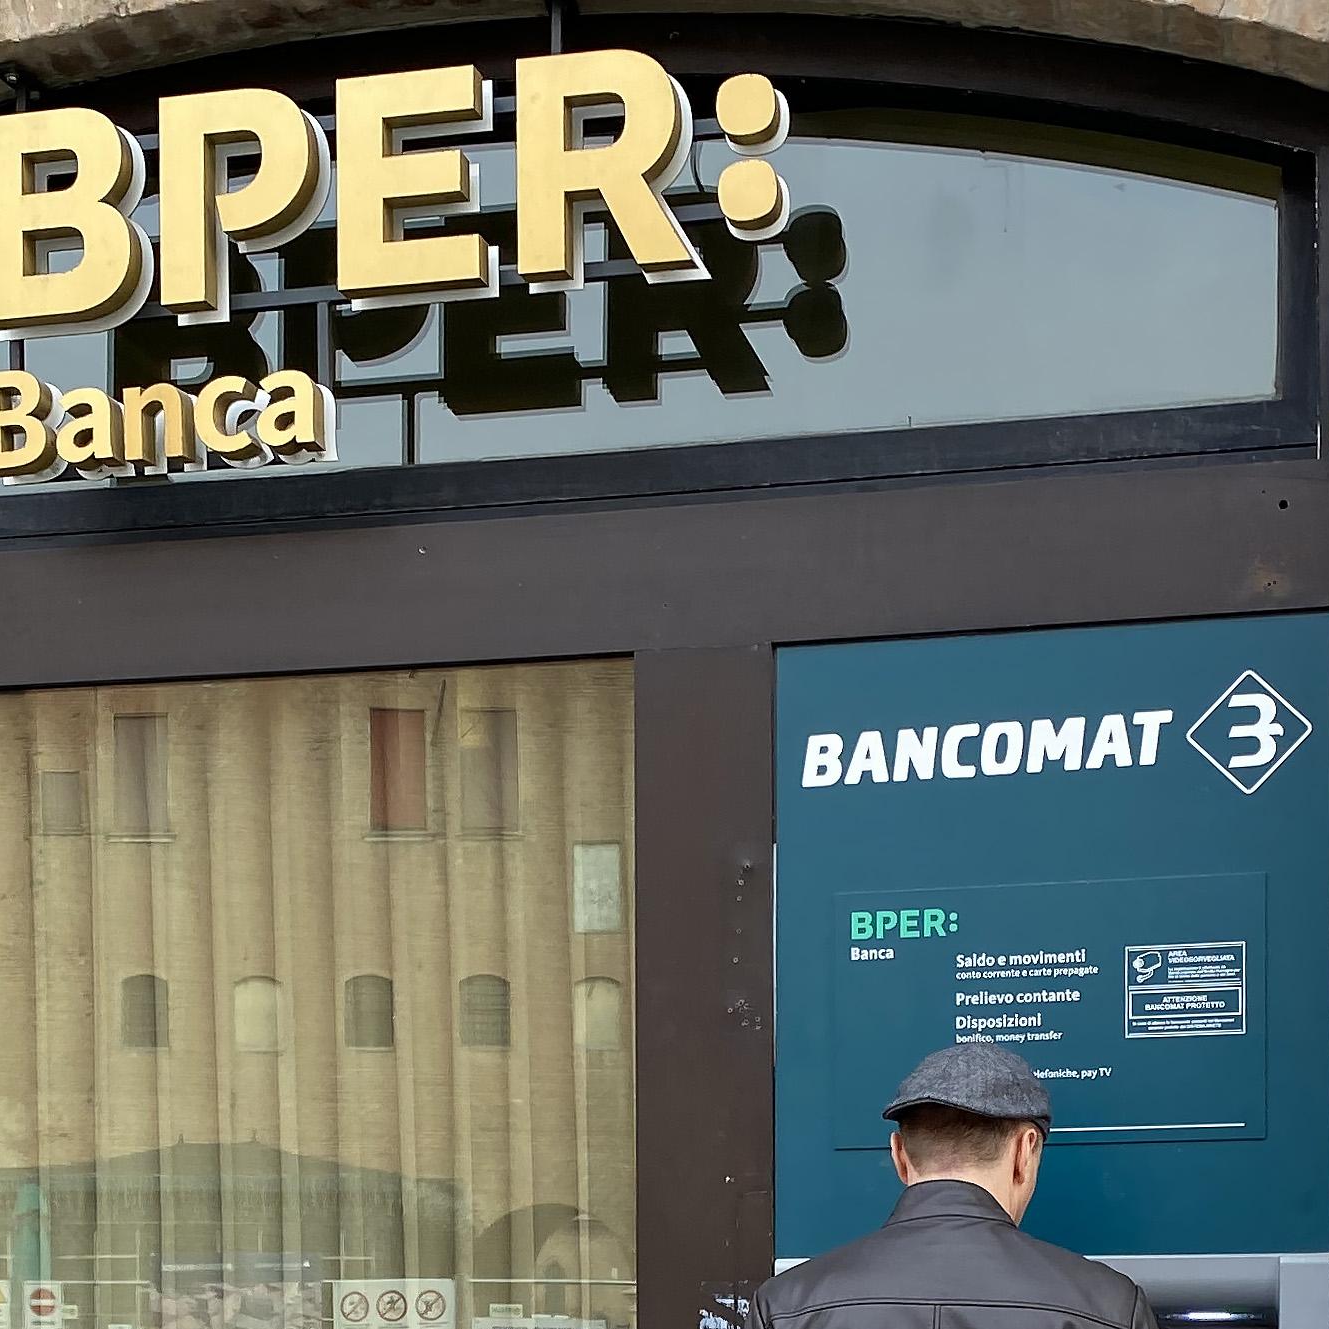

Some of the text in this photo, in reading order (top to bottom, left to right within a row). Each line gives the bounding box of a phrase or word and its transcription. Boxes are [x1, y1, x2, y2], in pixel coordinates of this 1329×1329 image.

[801, 709, 1173, 788] BANCOMAT
[850, 908, 959, 941] BPER:
[850, 945, 895, 962] Banca
[956, 948, 1086, 968] Saldo e movimenti
[955, 965, 1099, 980] conto corrente e carte prepagate
[955, 988, 1081, 1006] Prelievo contante
[955, 1013, 1042, 1031] Disposizioni
[996, 1033, 1026, 1043] money
[1027, 1030, 1063, 1041] transfer
[1081, 1069, 1098, 1079] pay
[1099, 1067, 1112, 1077] TV
